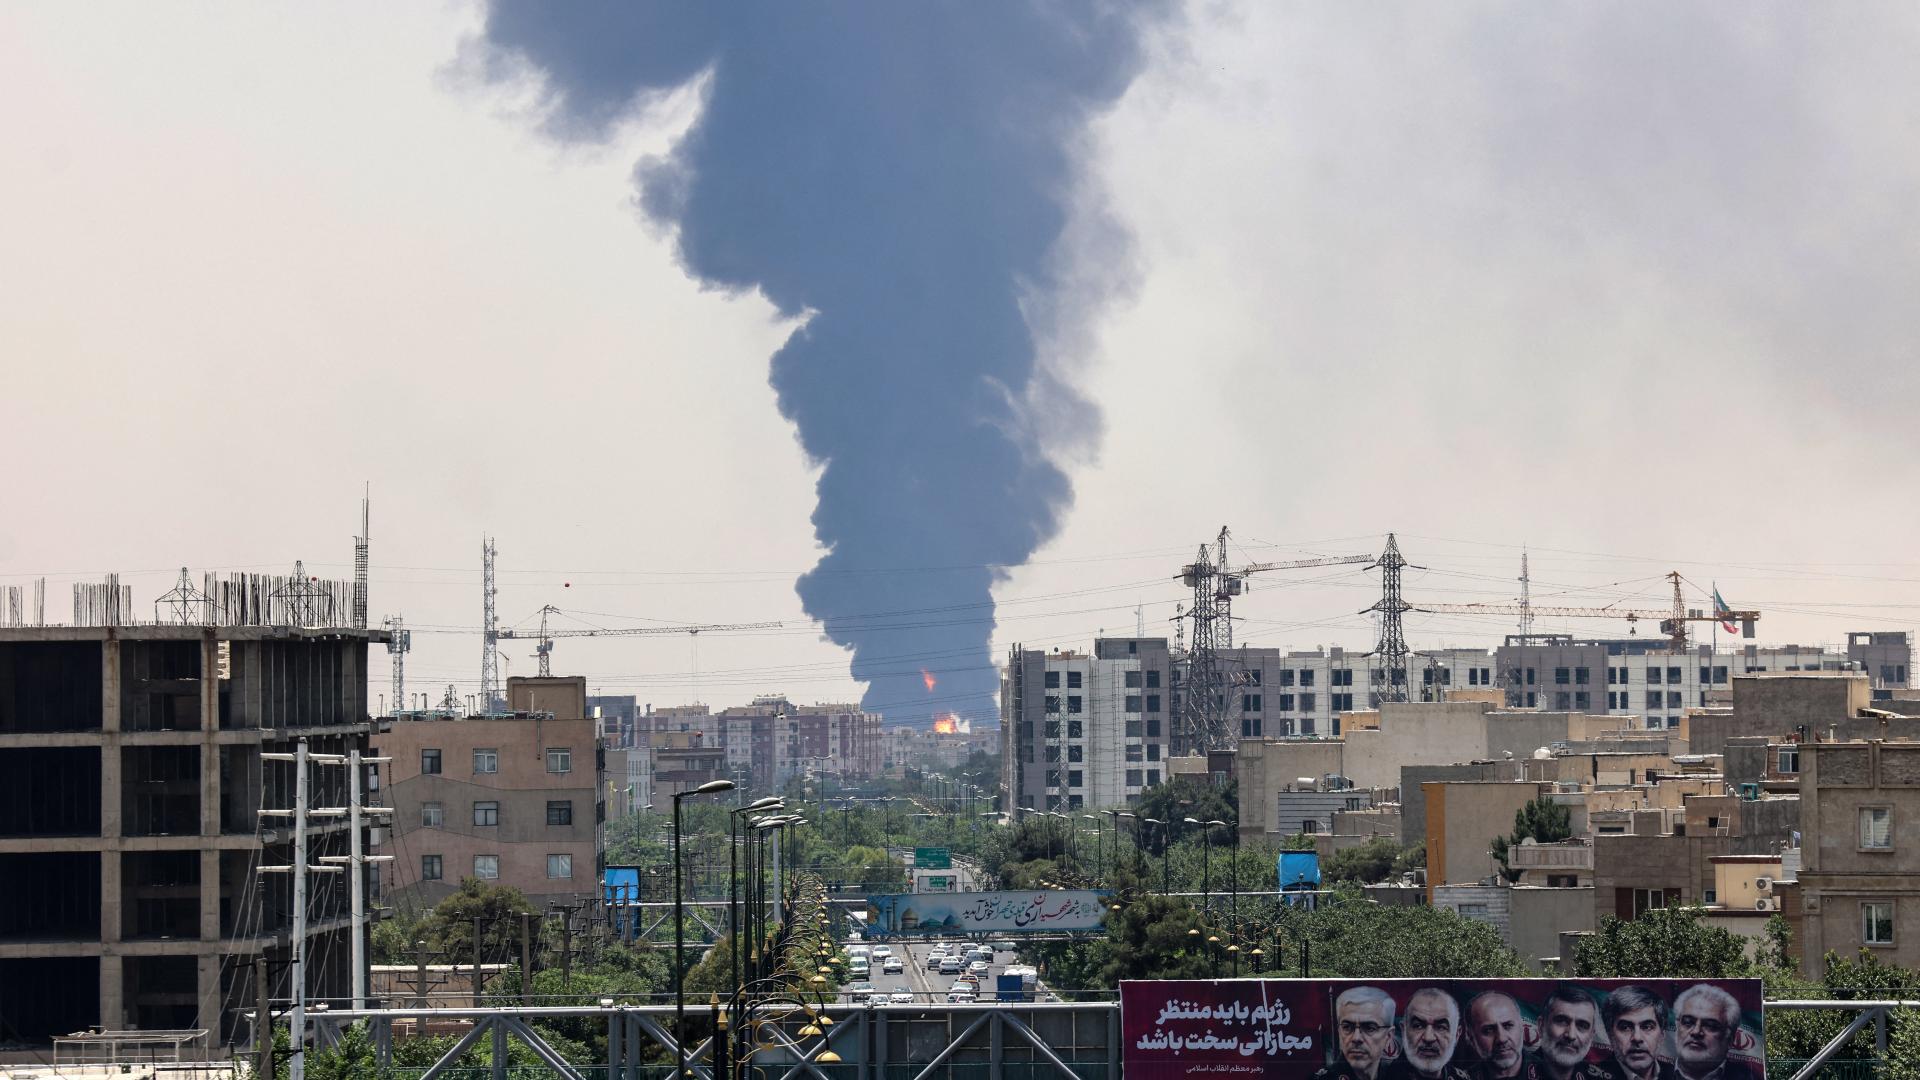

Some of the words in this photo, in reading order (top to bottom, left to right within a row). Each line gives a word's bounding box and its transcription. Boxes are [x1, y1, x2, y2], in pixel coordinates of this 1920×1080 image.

[975, 901, 994, 921] خوش
[1155, 998, 1213, 1025] منتظر
[1213, 1000, 1250, 1025] باید
[1252, 998, 1291, 1025] رژیم
[1136, 1028, 1184, 1055] باشد
[1185, 1029, 1239, 1050] سخت
[1239, 1029, 1312, 1056] مجازاتی
[1186, 1064, 1209, 1074] اسلامی
[1209, 1064, 1229, 1073] انقلاب
[1229, 1064, 1251, 1074] معظم
[1250, 1065, 1264, 1074] رهبر
